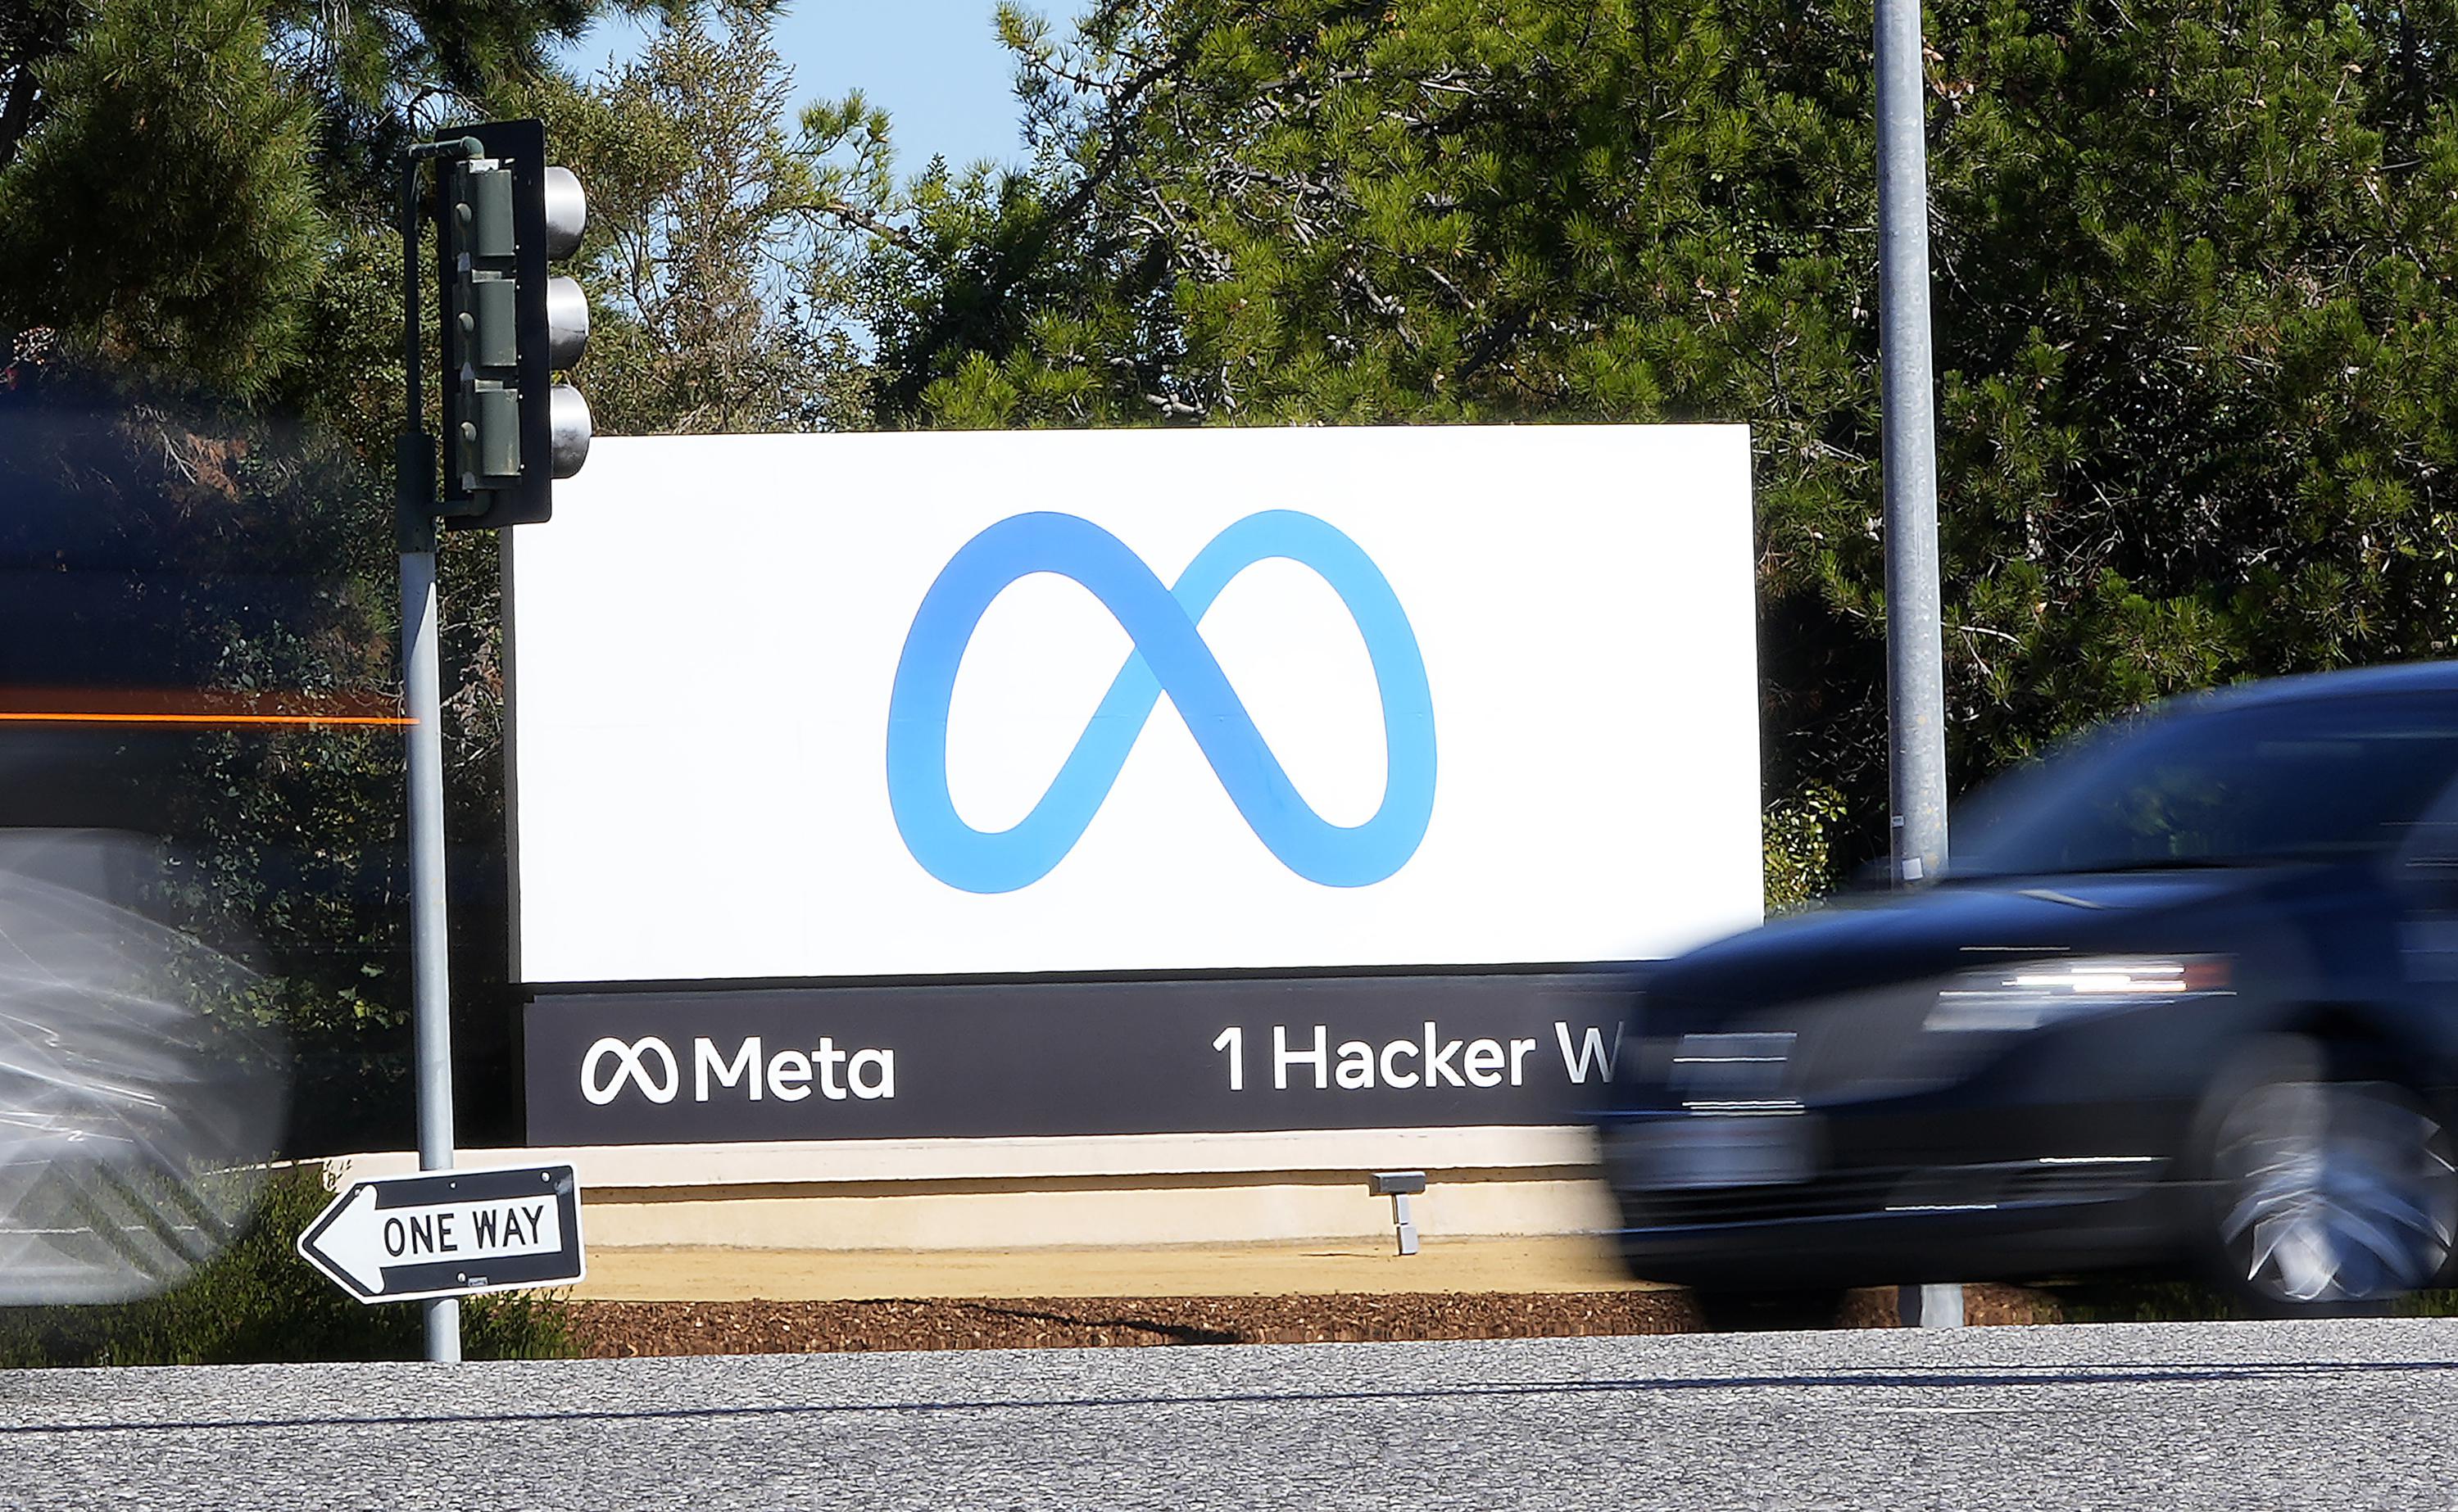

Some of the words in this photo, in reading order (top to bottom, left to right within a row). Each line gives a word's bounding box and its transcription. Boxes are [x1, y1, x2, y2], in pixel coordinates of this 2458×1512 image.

[694, 1036, 895, 1102] Meta
[1212, 1025, 1243, 1090] 1
[1272, 1021, 1536, 1090] Hacker
[383, 1212, 458, 1257] ONE
[472, 1205, 544, 1248] WAY
